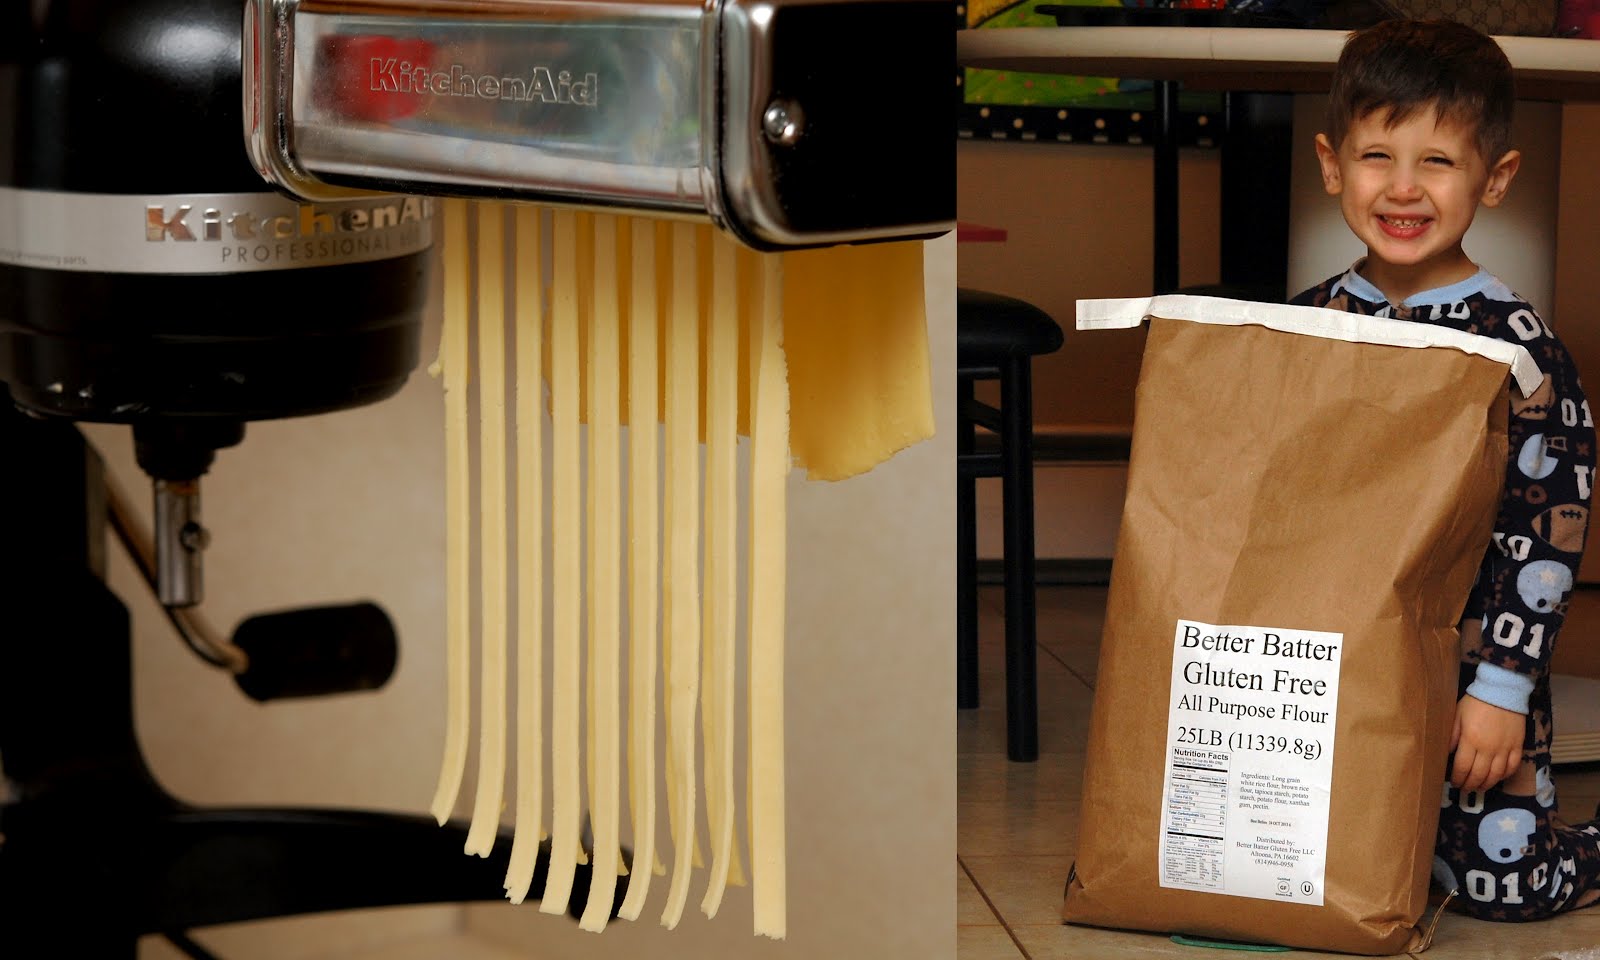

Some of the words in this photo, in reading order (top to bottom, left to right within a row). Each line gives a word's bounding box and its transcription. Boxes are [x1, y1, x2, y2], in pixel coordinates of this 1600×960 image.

[370, 57, 598, 106] KitchenAid
[222, 232, 391, 263] PROFESSIONAL
[1561, 398, 1594, 428] 01
[1181, 625, 1255, 654] Better
[1261, 633, 1338, 661] Batter
[1492, 611, 1546, 659] 01
[1183, 661, 1263, 691] Gluten
[1271, 669, 1327, 697] Free
[1177, 694, 1202, 712] All
[1208, 696, 1276, 720] Purpose
[1281, 704, 1329, 724] Flour
[1174, 748, 1206, 758] Nutrition
[1208, 752, 1229, 761] Facts
[1177, 726, 1223, 746] 25LB
[1228, 731, 1322, 760] (11339.8g)
[1241, 772, 1270, 780] Ingredients:
[1271, 775, 1286, 783] Long
[1465, 869, 1524, 905] 01
